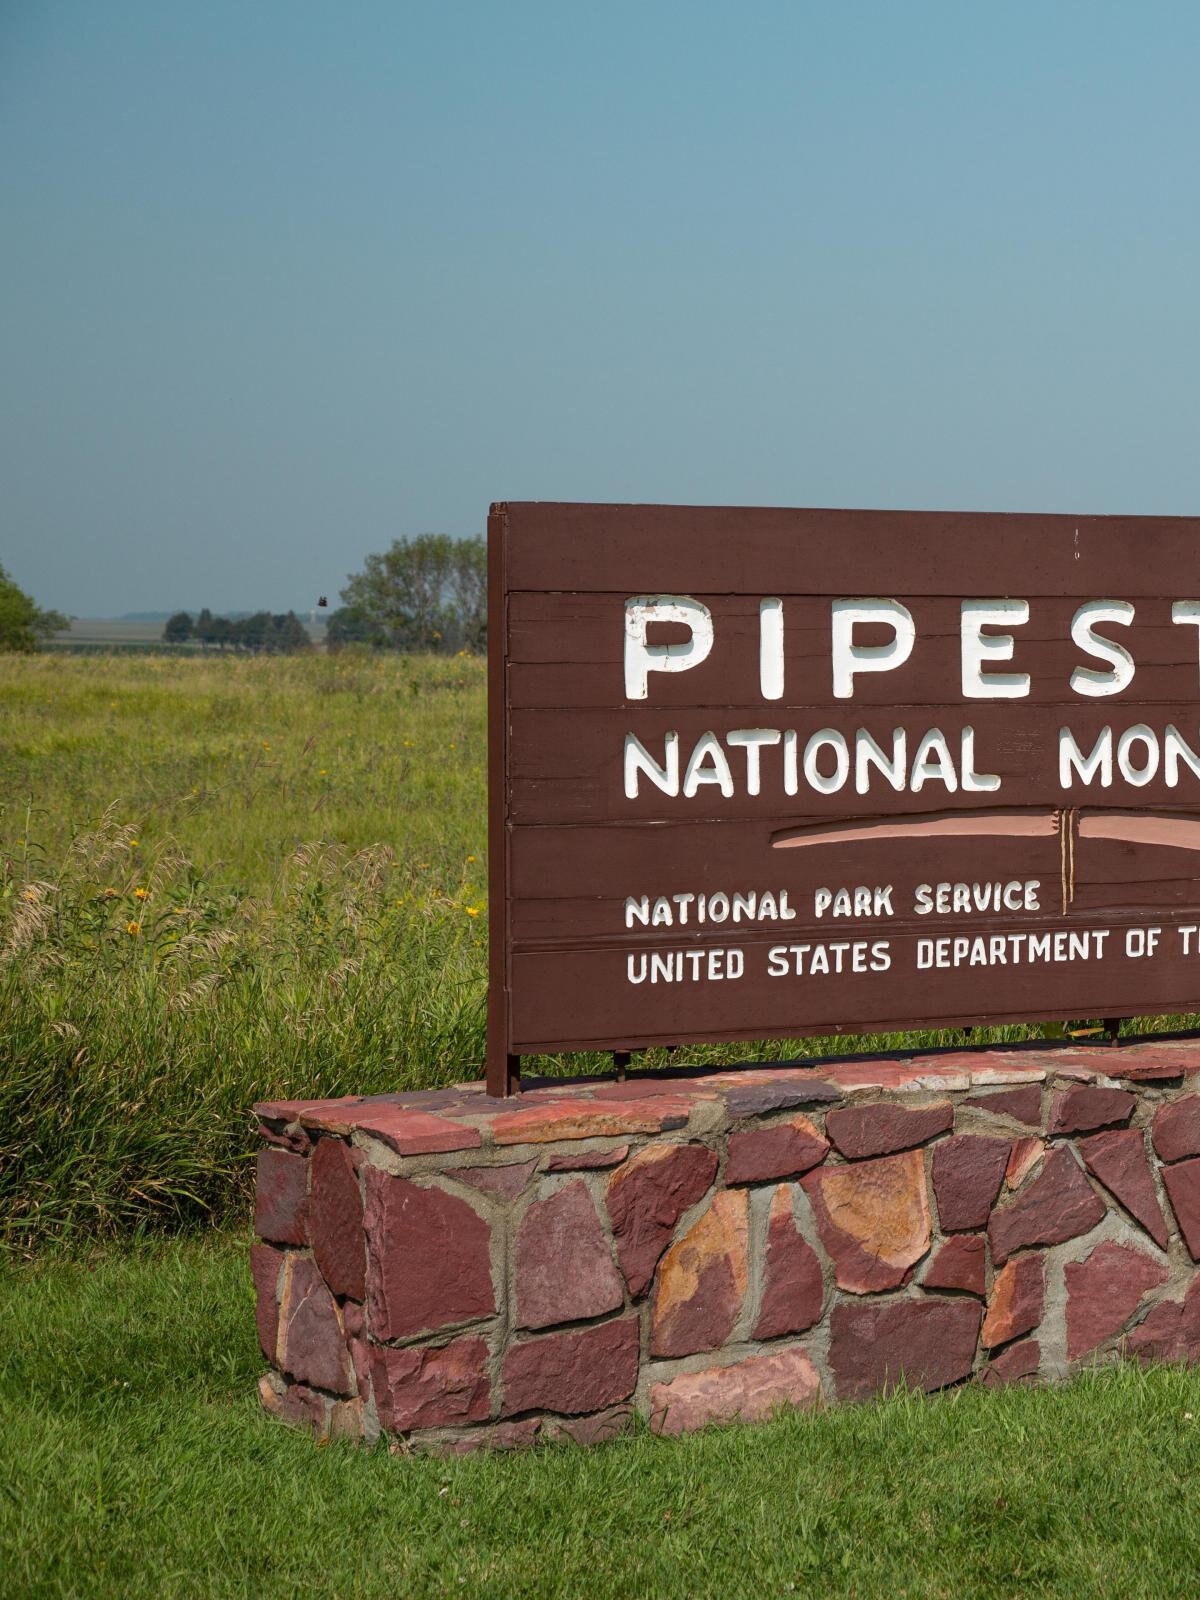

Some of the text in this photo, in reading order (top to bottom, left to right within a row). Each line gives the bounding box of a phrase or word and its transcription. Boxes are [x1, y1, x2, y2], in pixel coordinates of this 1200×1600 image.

[623, 725, 1002, 800] NATIONAL
[625, 879, 1041, 929] NATIONAL PARK SERVICE
[627, 948, 745, 985] UNITED
[767, 940, 892, 977] STATES
[916, 929, 1110, 970] DEPARTMENT
[1125, 927, 1162, 958] OF
